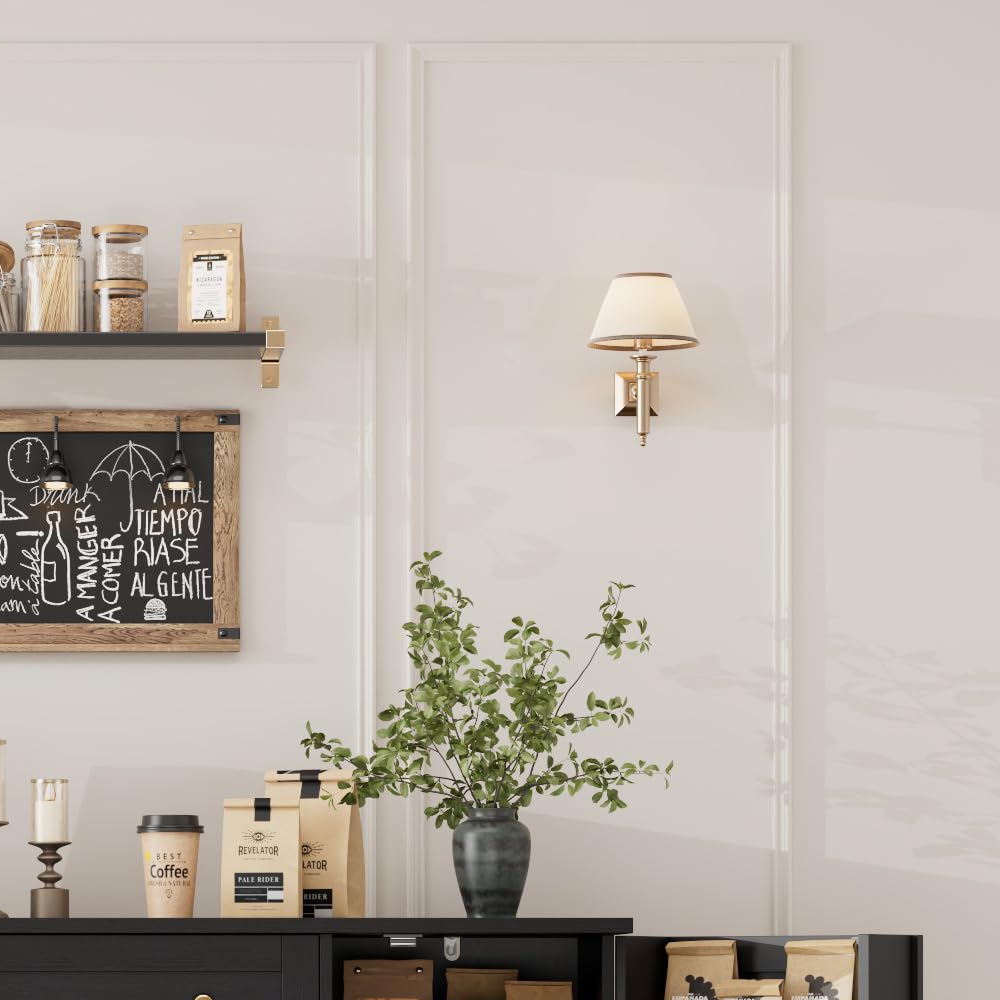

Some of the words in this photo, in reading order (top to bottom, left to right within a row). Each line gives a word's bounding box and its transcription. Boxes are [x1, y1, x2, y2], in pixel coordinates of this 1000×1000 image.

[135, 509, 202, 536] TIEMPO
[75, 504, 98, 600] MANGER
[134, 539, 199, 566] RIASE
[101, 533, 123, 604] COMER
[131, 572, 153, 597] AL
[157, 568, 213, 600] GENTE
[239, 846, 278, 856] REVELATOR
[151, 864, 188, 879] Coffee
